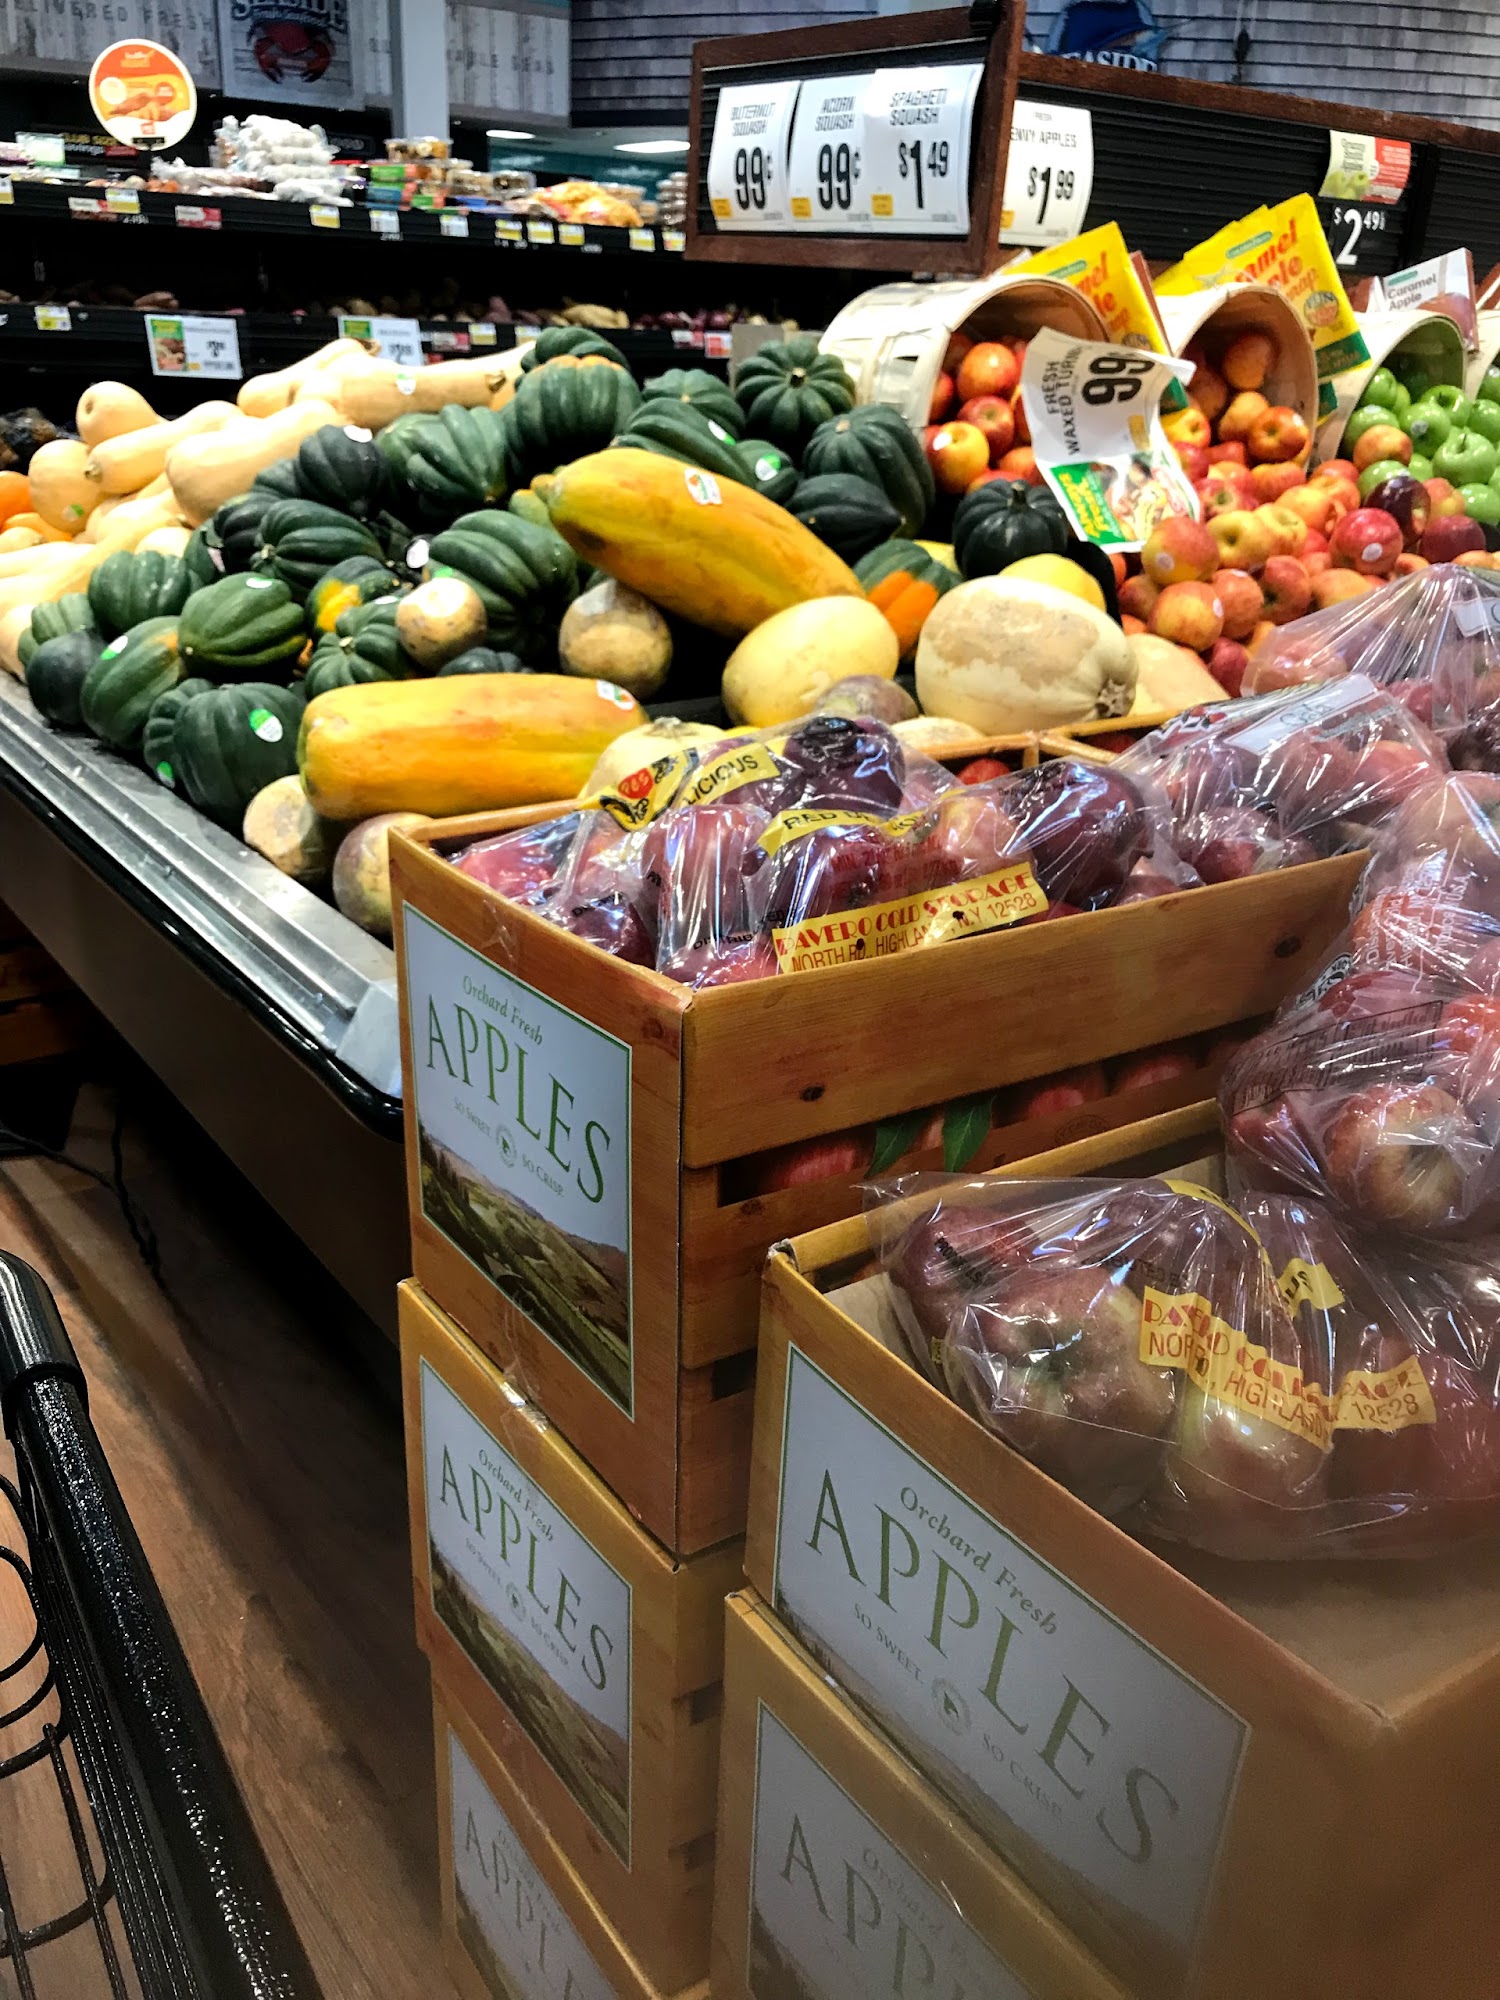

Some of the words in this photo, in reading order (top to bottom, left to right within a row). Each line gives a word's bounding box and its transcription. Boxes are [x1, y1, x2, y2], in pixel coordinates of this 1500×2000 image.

[730, 102, 777, 121] BUTTERNUT
[814, 114, 856, 131] SQUASH
[820, 96, 856, 114] ACORN
[888, 88, 949, 108] SPAGHETTI
[889, 107, 942, 126] SQUASH
[732, 119, 769, 136] SQUASH
[1038, 131, 1078, 149] APPLES
[1387, 273, 1437, 300] Caramel
[1388, 292, 1422, 312] Apple
[1041, 360, 1060, 415] FRESH
[1058, 394, 1081, 456] WAXED
[683, 754, 759, 806] LICIOUS
[776, 916, 873, 957] PAVERO
[875, 902, 922, 932] COLD
[922, 871, 1031, 918] STORAGE
[791, 946, 845, 974] NORTH
[986, 892, 1038, 920] 12528
[462, 974, 509, 1018] Orchard
[510, 1005, 544, 1046] Fresh
[426, 994, 611, 1204] APPLES
[477, 1448, 523, 1505] Orchard
[523, 1499, 555, 1544] Fresh
[439, 1443, 615, 1693] APPLES
[899, 1486, 990, 1575] Orchard
[993, 1565, 1060, 1636] Fresh
[804, 1468, 1180, 1865] APPLES
